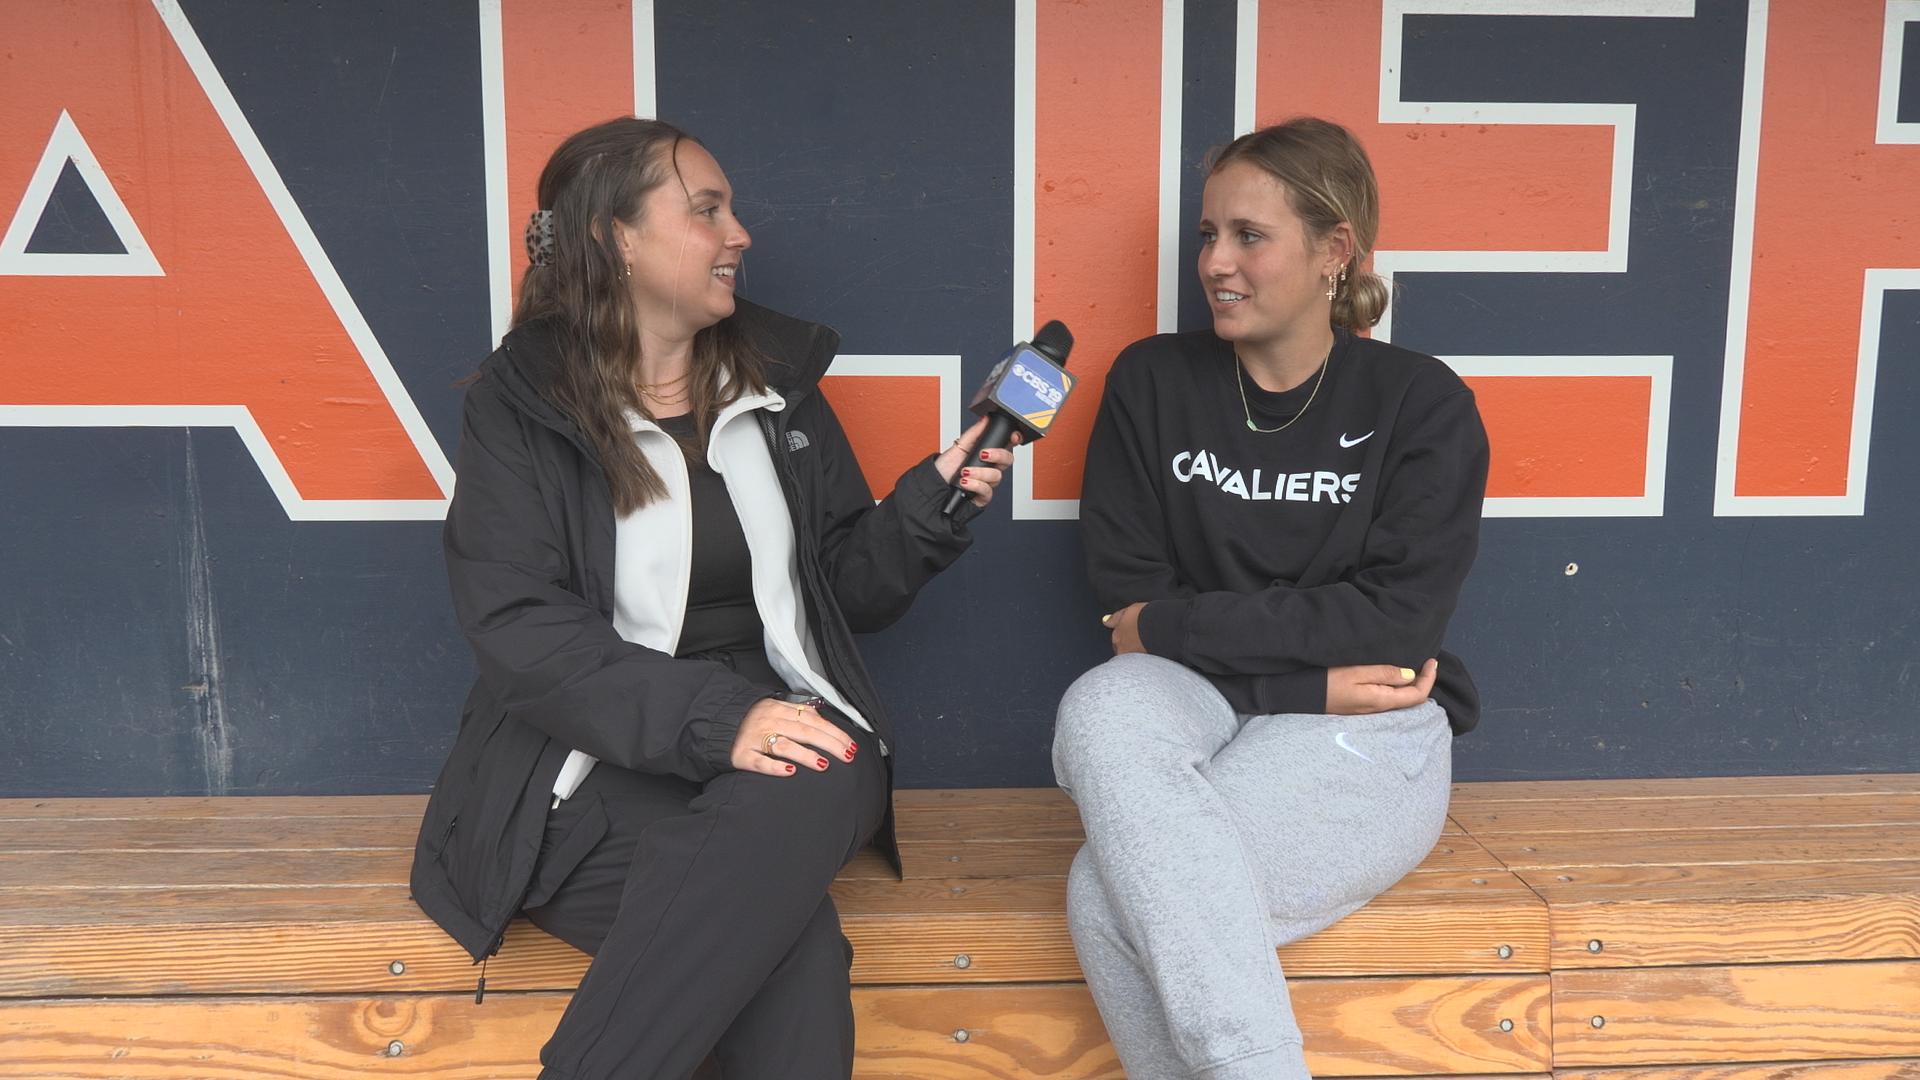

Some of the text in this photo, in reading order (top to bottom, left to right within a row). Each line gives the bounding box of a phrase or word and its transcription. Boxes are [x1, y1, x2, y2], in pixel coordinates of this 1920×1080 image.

[1022, 371, 1050, 394] CBS
[1048, 387, 1063, 403] 19
[1172, 449, 1361, 504] CAVALIERS
